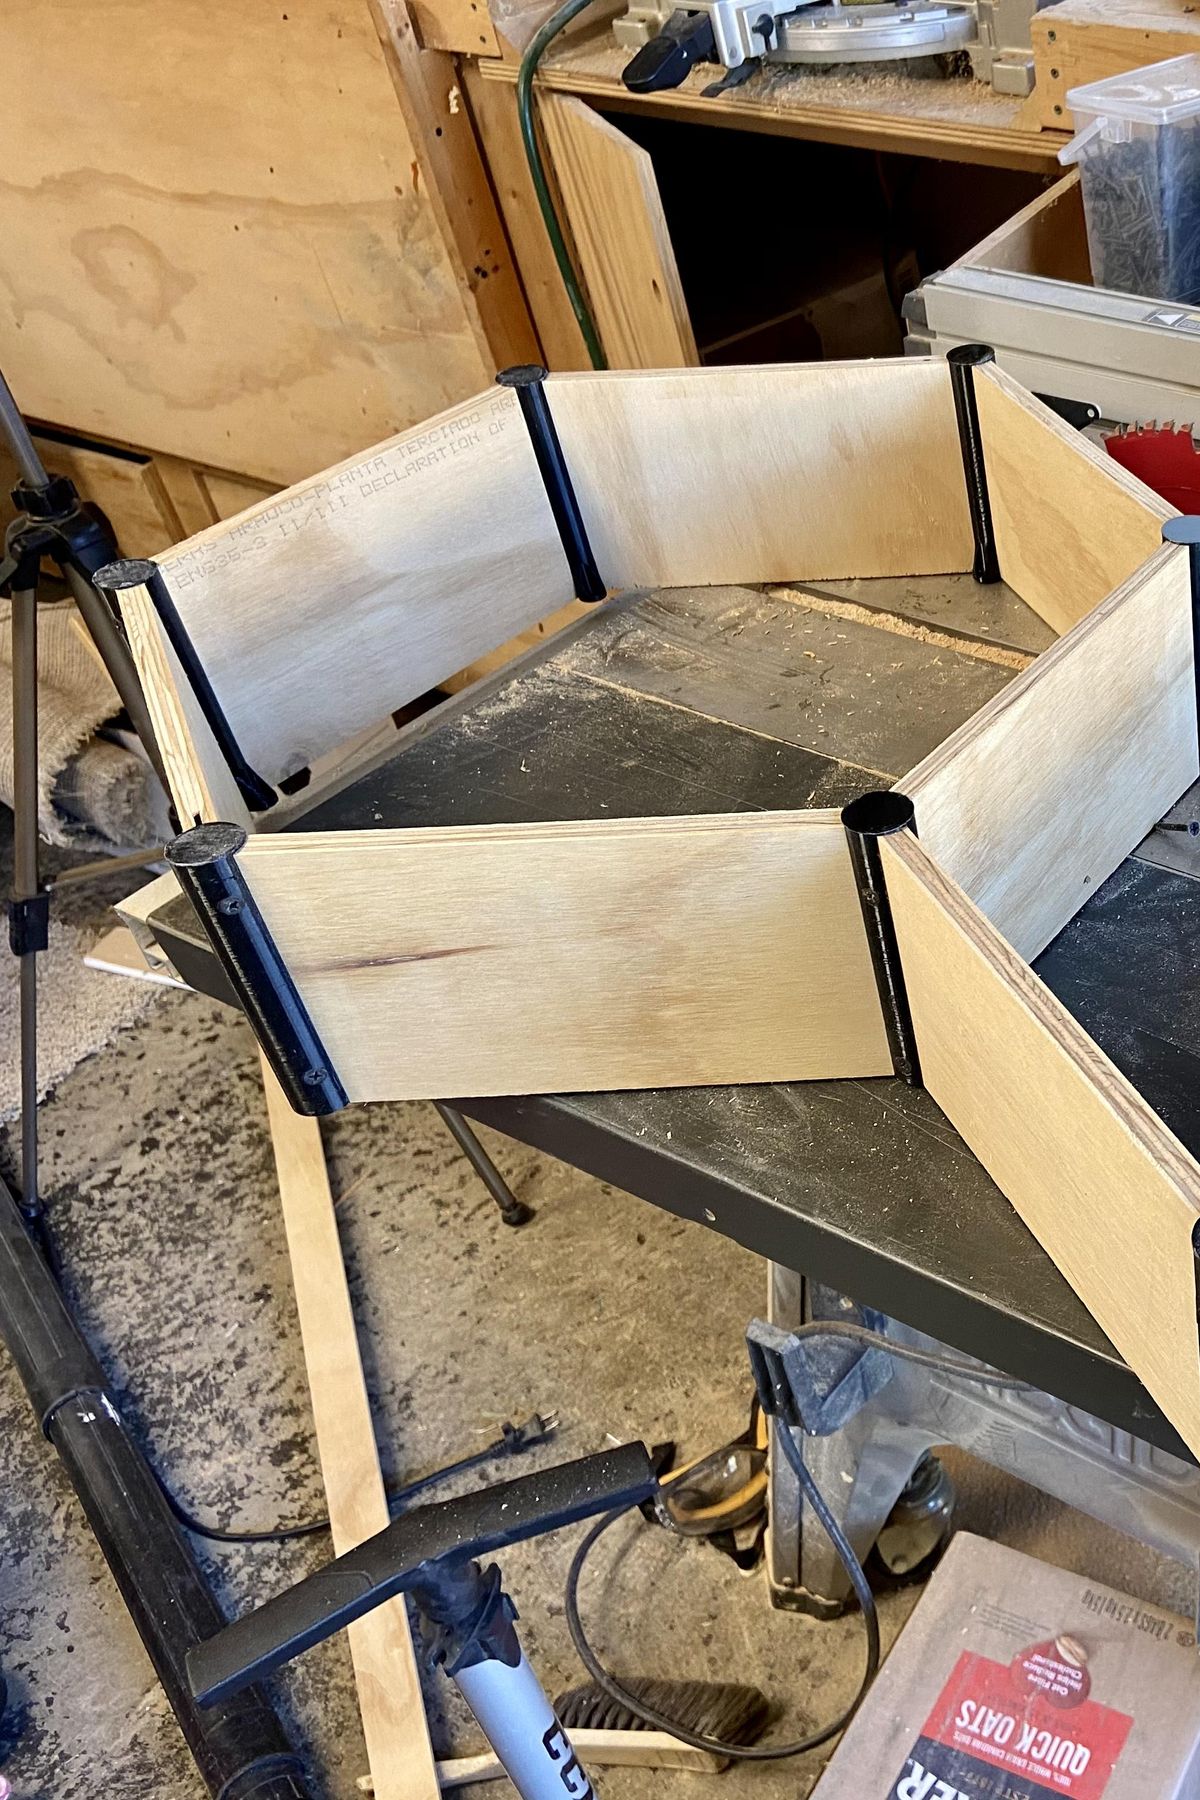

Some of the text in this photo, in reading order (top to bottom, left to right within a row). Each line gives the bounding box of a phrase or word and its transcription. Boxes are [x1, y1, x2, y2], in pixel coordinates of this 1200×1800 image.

[358, 434, 482, 499] DECLARATION
[955, 1699, 1015, 1744] OATS
[1014, 1722, 1091, 1776] QUICK
